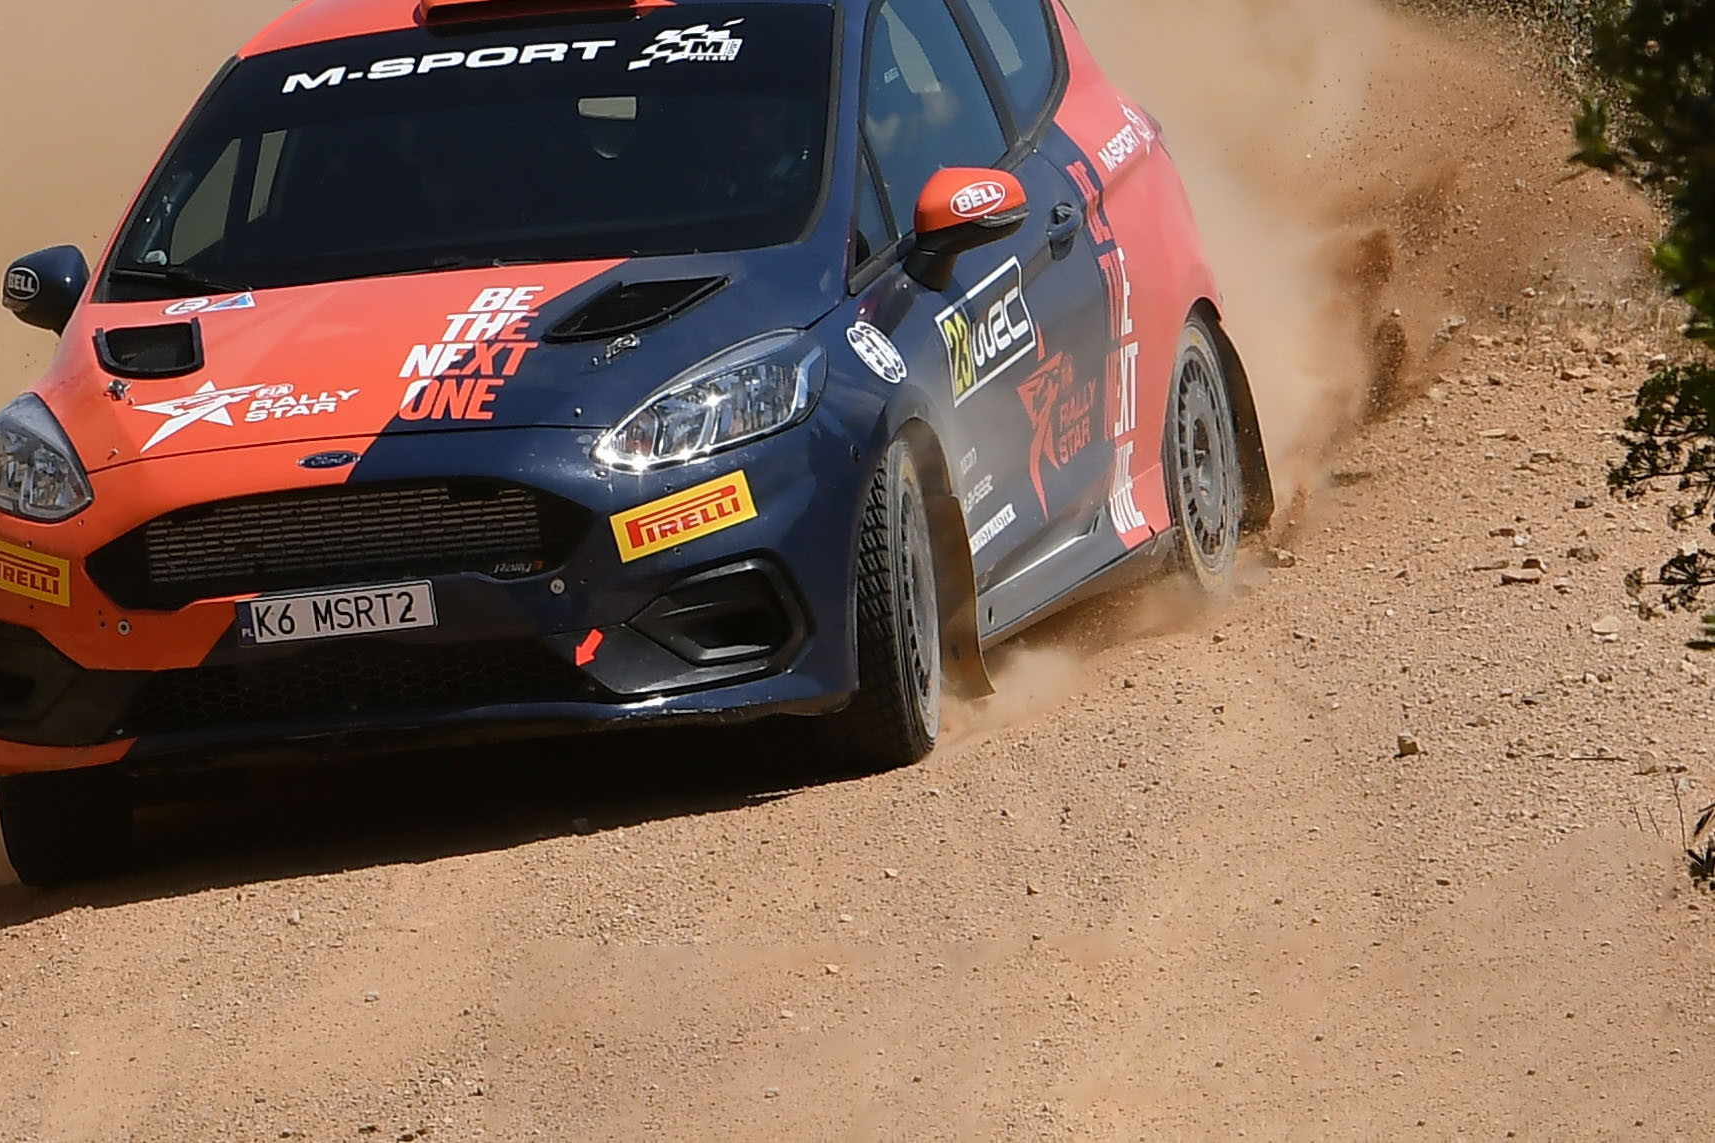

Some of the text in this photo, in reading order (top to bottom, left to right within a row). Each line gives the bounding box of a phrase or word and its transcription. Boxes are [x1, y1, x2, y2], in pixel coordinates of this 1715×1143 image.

[282, 39, 616, 93] M-SPORT
[1097, 123, 1142, 173] M-SPORT
[955, 185, 1002, 213] BELL
[7, 271, 36, 293] BELL
[468, 286, 544, 312] BE
[441, 312, 540, 342] THE
[398, 342, 540, 378] NEXT
[943, 312, 972, 397] 23
[248, 389, 361, 411] RALLY
[257, 385, 290, 398] FIA
[398, 378, 505, 421] ONE
[244, 402, 337, 423] STAR
[625, 485, 742, 549] PIRELLI
[254, 591, 417, 638] K6 MSRT2
[241, 628, 254, 639] PL
